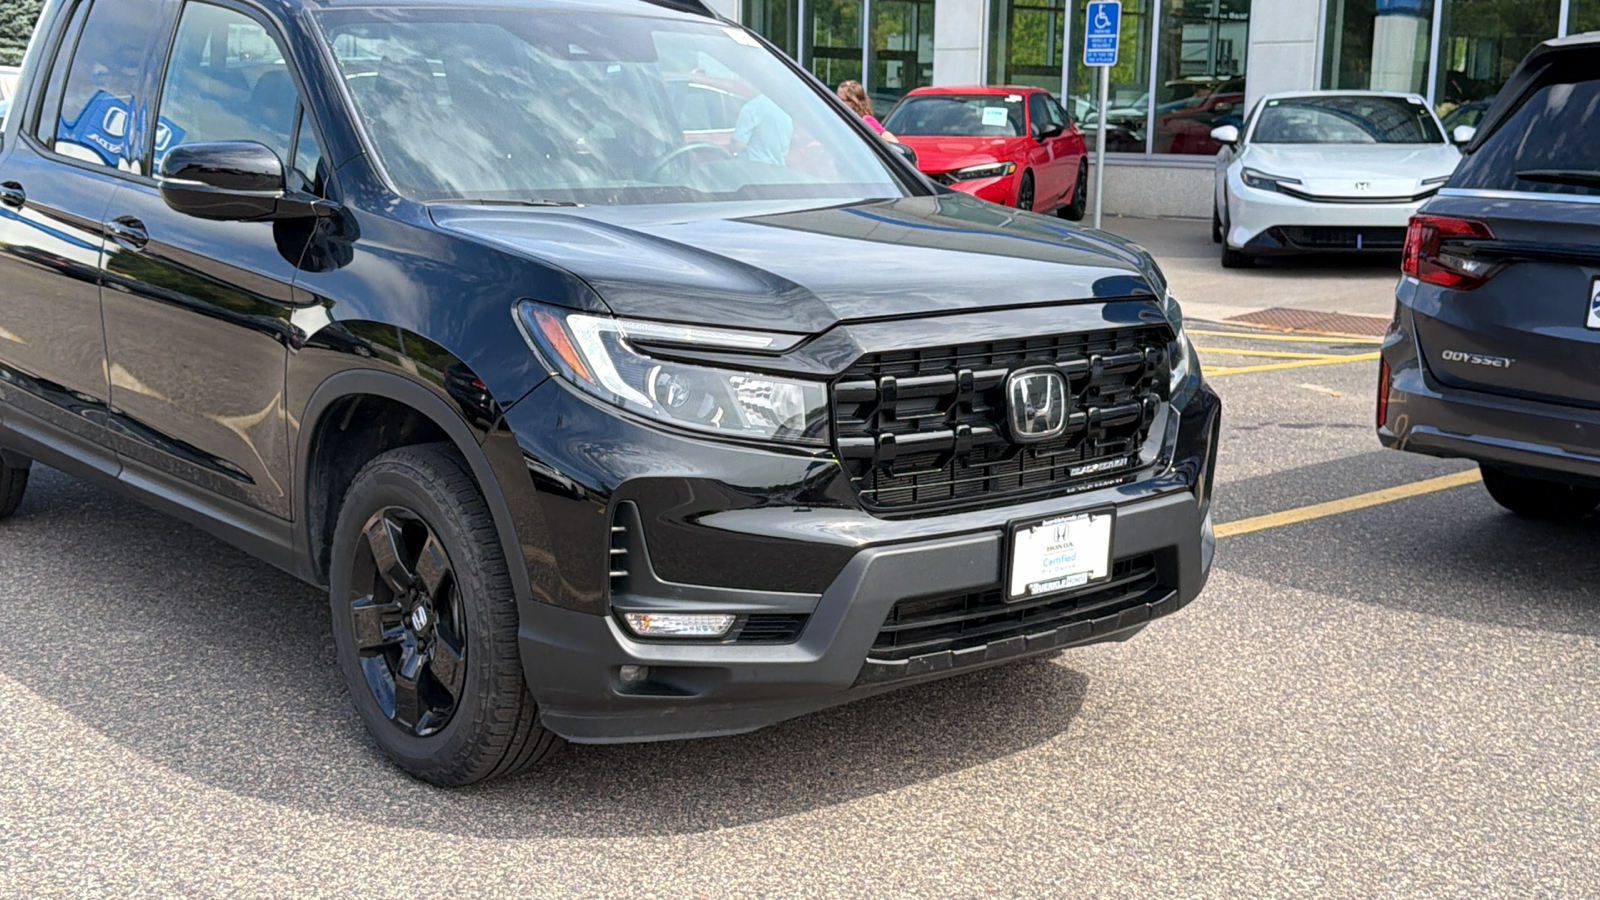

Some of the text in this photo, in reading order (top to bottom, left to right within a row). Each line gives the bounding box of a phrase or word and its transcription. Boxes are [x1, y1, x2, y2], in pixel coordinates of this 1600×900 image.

[1441, 350, 1511, 368] ODYSSEY
[1046, 541, 1074, 552] HONDA
[1043, 552, 1077, 567] Certified
